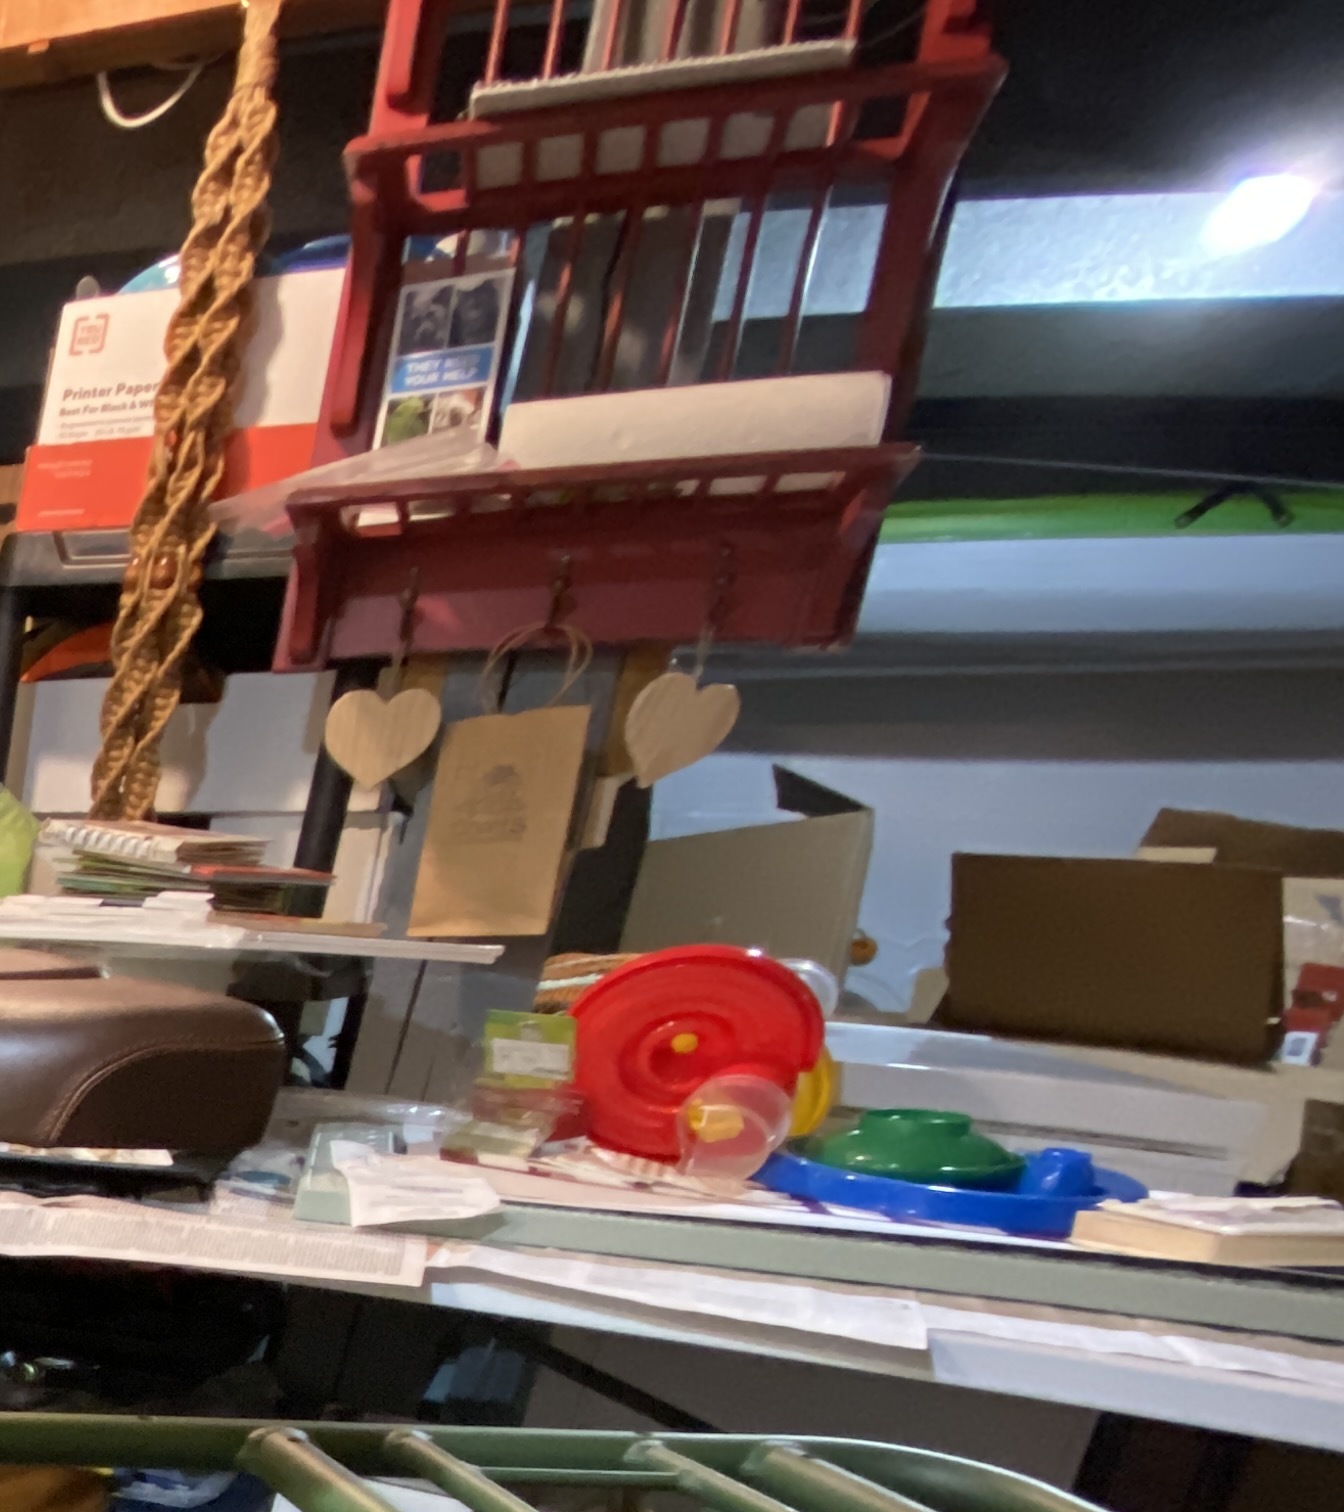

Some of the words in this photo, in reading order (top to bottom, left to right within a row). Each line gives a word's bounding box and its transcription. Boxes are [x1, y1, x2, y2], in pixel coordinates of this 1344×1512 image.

[62, 385, 113, 401] Printer
[115, 381, 159, 398] Paper
[59, 405, 80, 416] Best
